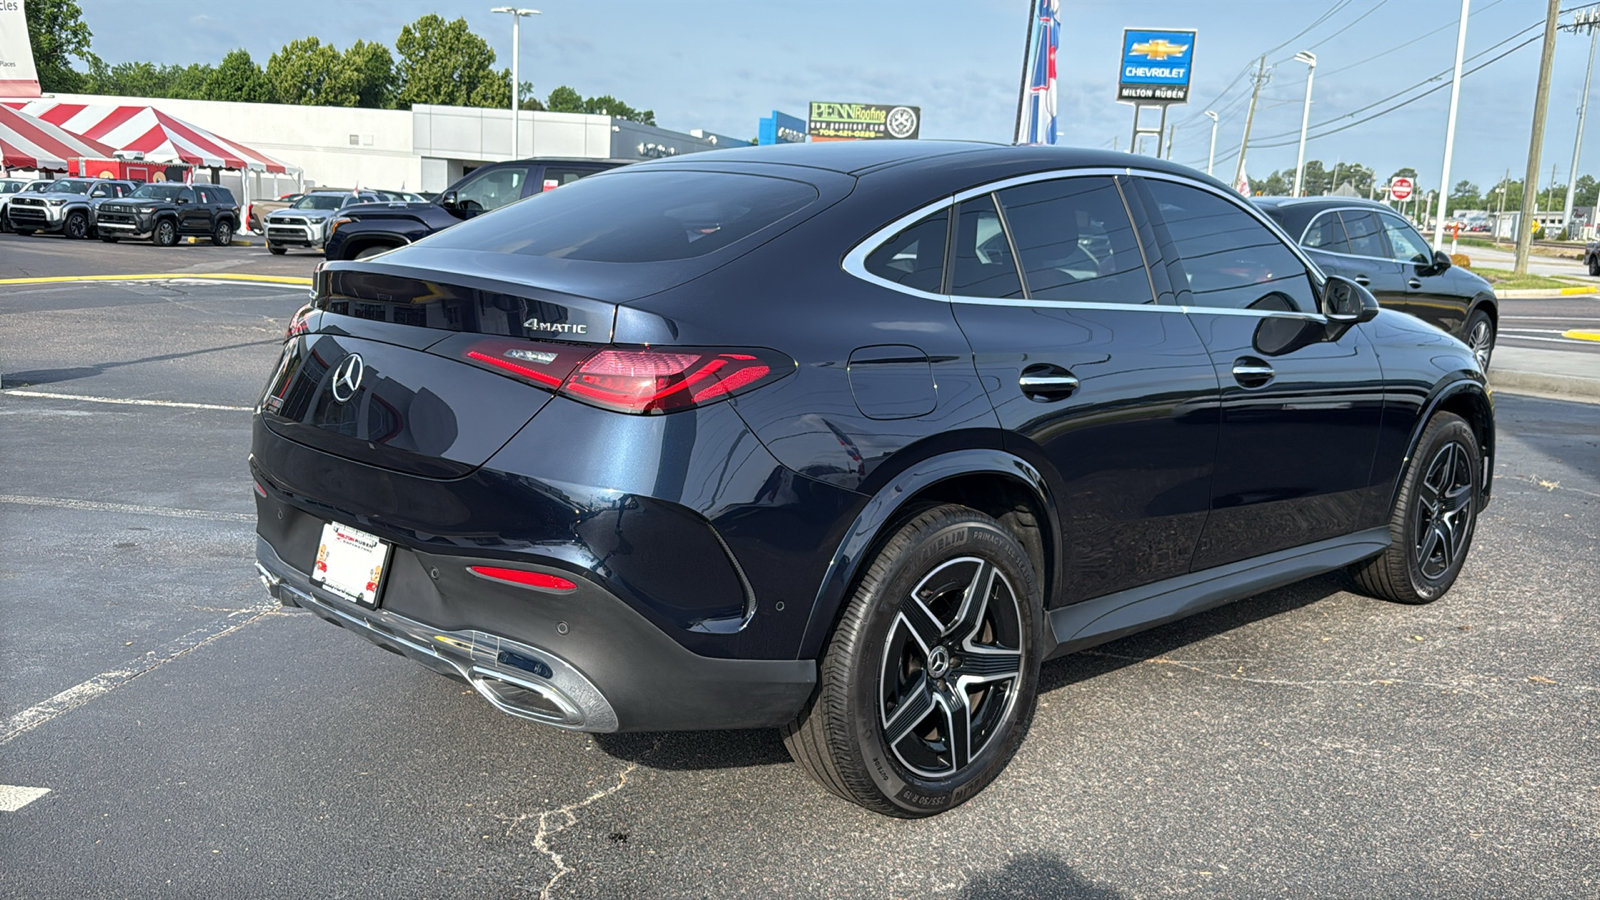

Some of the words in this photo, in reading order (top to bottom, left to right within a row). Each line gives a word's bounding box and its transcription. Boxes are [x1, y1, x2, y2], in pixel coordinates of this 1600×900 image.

[1125, 67, 1185, 78] CHEVROLET
[1121, 88, 1153, 97] MILTON
[811, 103, 856, 119] PENN
[855, 107, 886, 123] Roofing
[523, 318, 587, 334] 4MATIC
[336, 532, 355, 543] MILTON
[354, 539, 374, 549] RUBEN
[973, 531, 1003, 548] PRIMACY
[1003, 544, 1015, 558] ALL
[872, 757, 889, 782] OUTSIDE
[918, 796, 946, 805] 255/50
